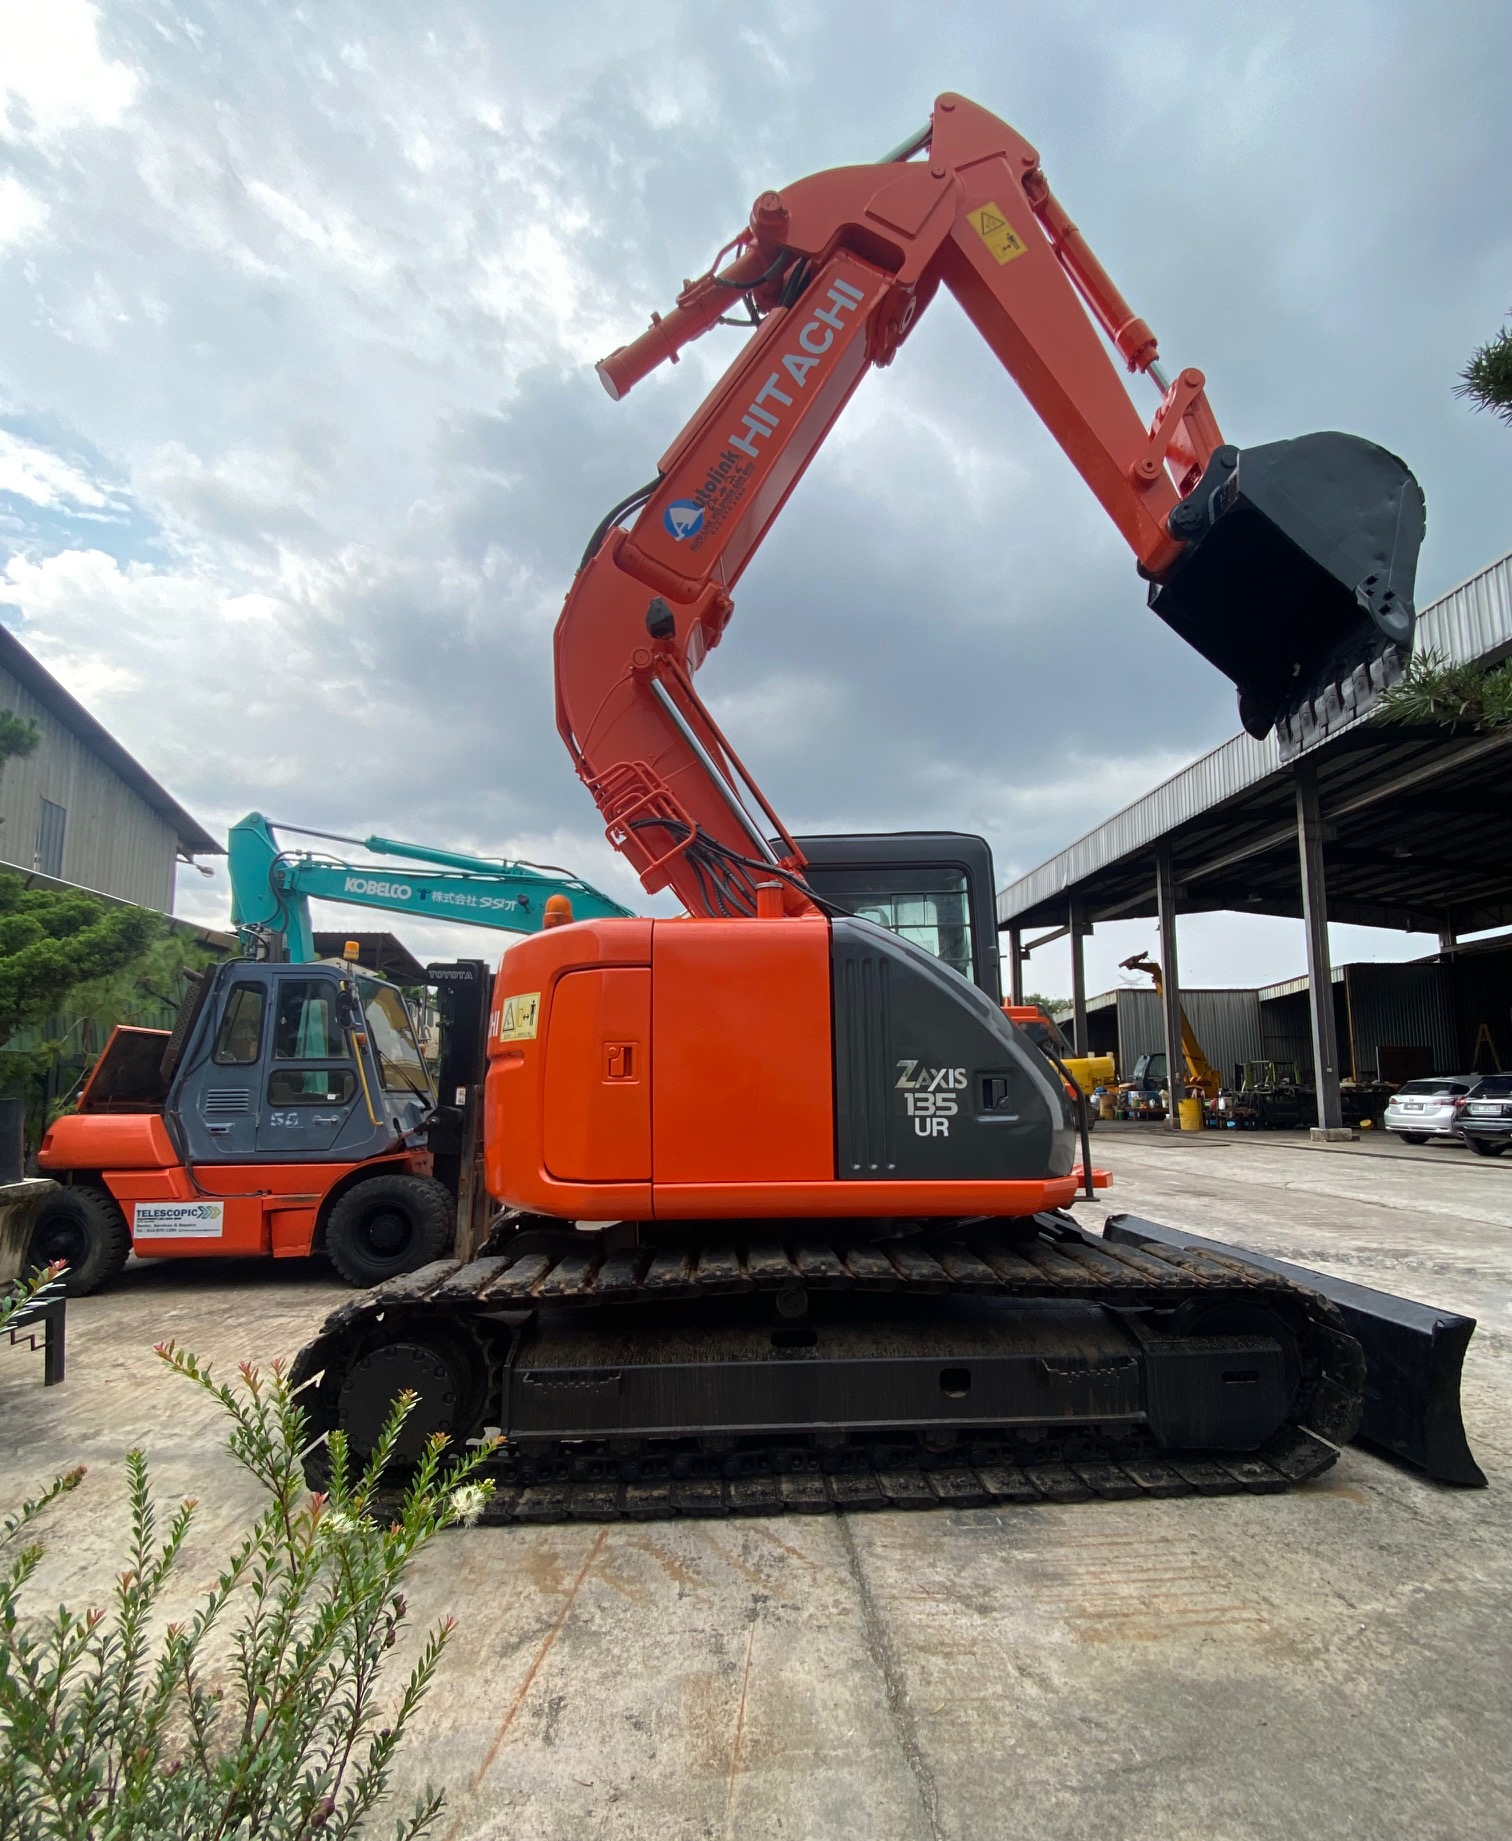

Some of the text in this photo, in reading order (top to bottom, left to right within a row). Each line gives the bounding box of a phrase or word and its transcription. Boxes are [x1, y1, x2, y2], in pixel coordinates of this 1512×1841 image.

[729, 278, 864, 458] HITACHI
[344, 877, 411, 900] KOBELCO
[432, 891, 477, 906] 株式会社
[429, 970, 473, 979] TOYOTA
[904, 1093, 958, 1116] 135
[915, 1118, 949, 1137] UR
[137, 1209, 198, 1217] TELESCOPIC
